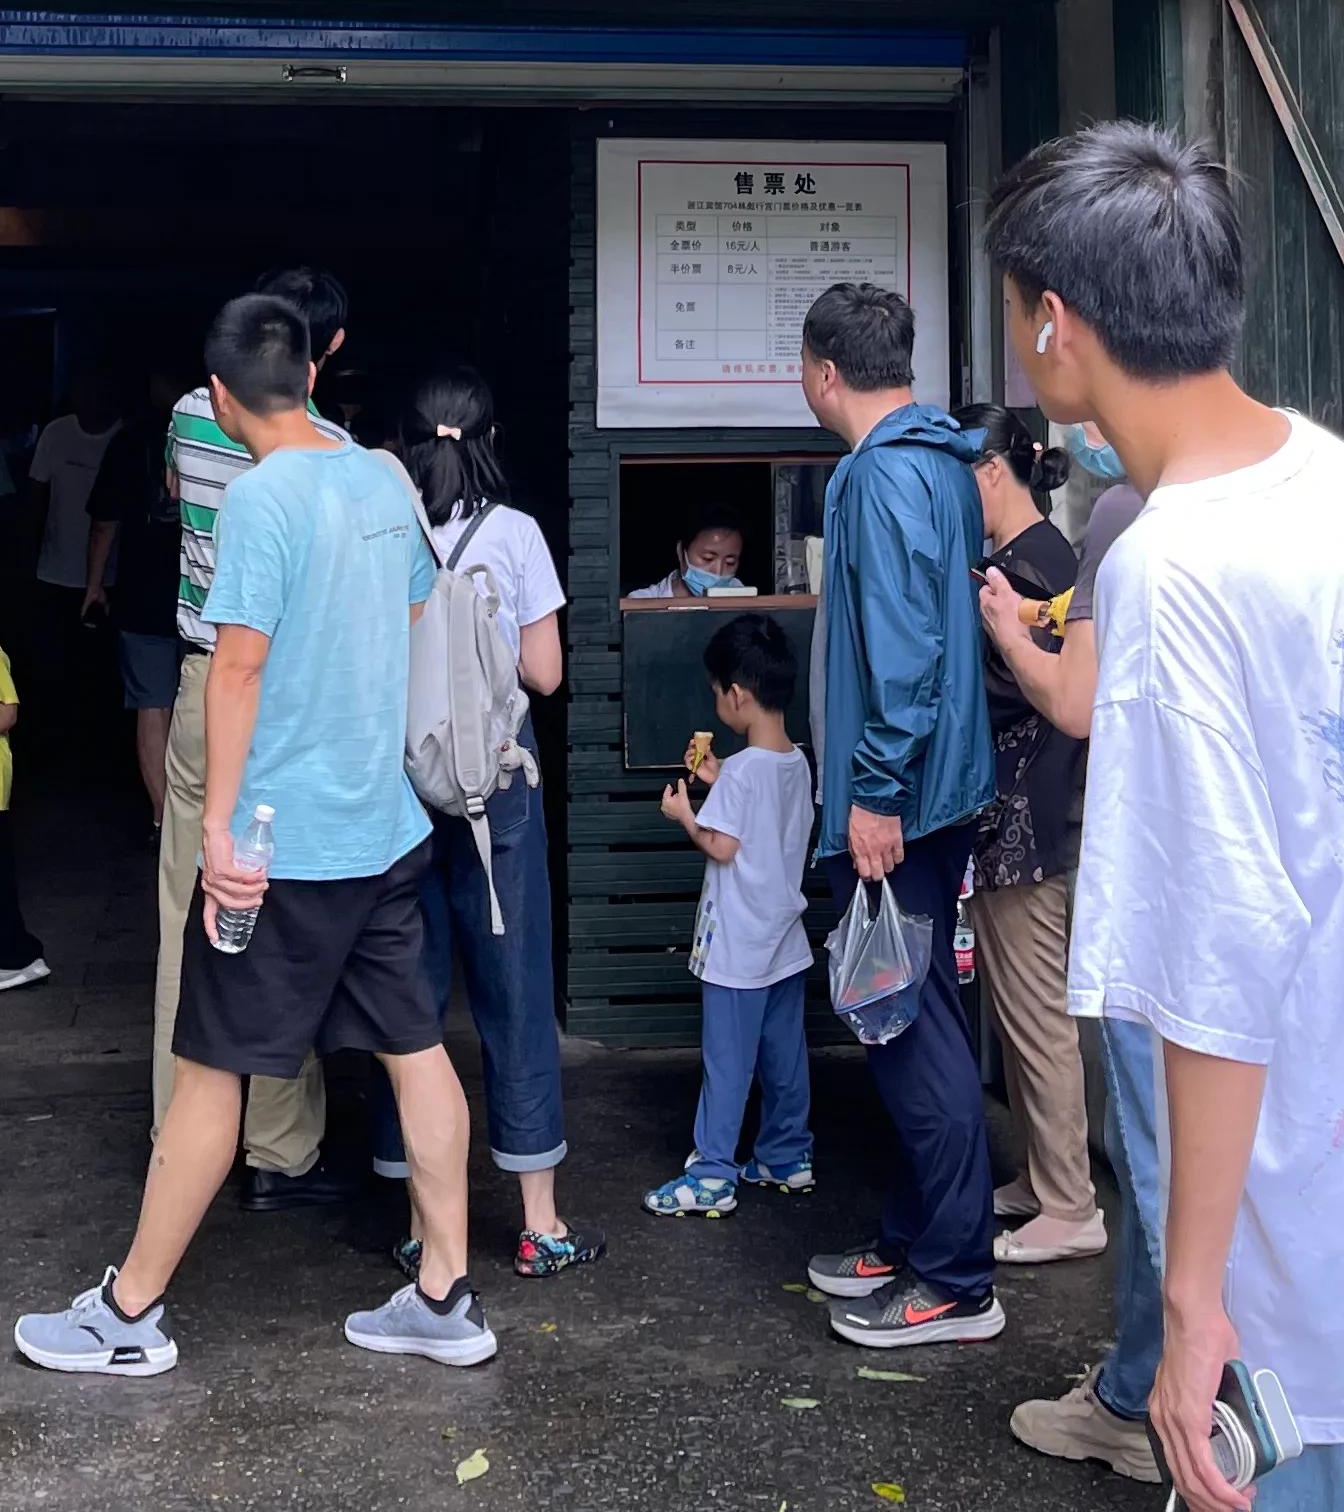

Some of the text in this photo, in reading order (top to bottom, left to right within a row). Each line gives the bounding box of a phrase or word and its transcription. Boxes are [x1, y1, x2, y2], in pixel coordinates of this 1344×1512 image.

[734, 171, 817, 195] 售票处
[675, 220, 697, 232] 类型
[731, 221, 753, 232] 价格
[819, 221, 841, 232] 对象
[670, 240, 702, 251] 全票价
[809, 241, 851, 252] 普通游客
[670, 263, 702, 275] 半价票
[675, 301, 696, 313] 免票
[674, 339, 696, 350] 备注
